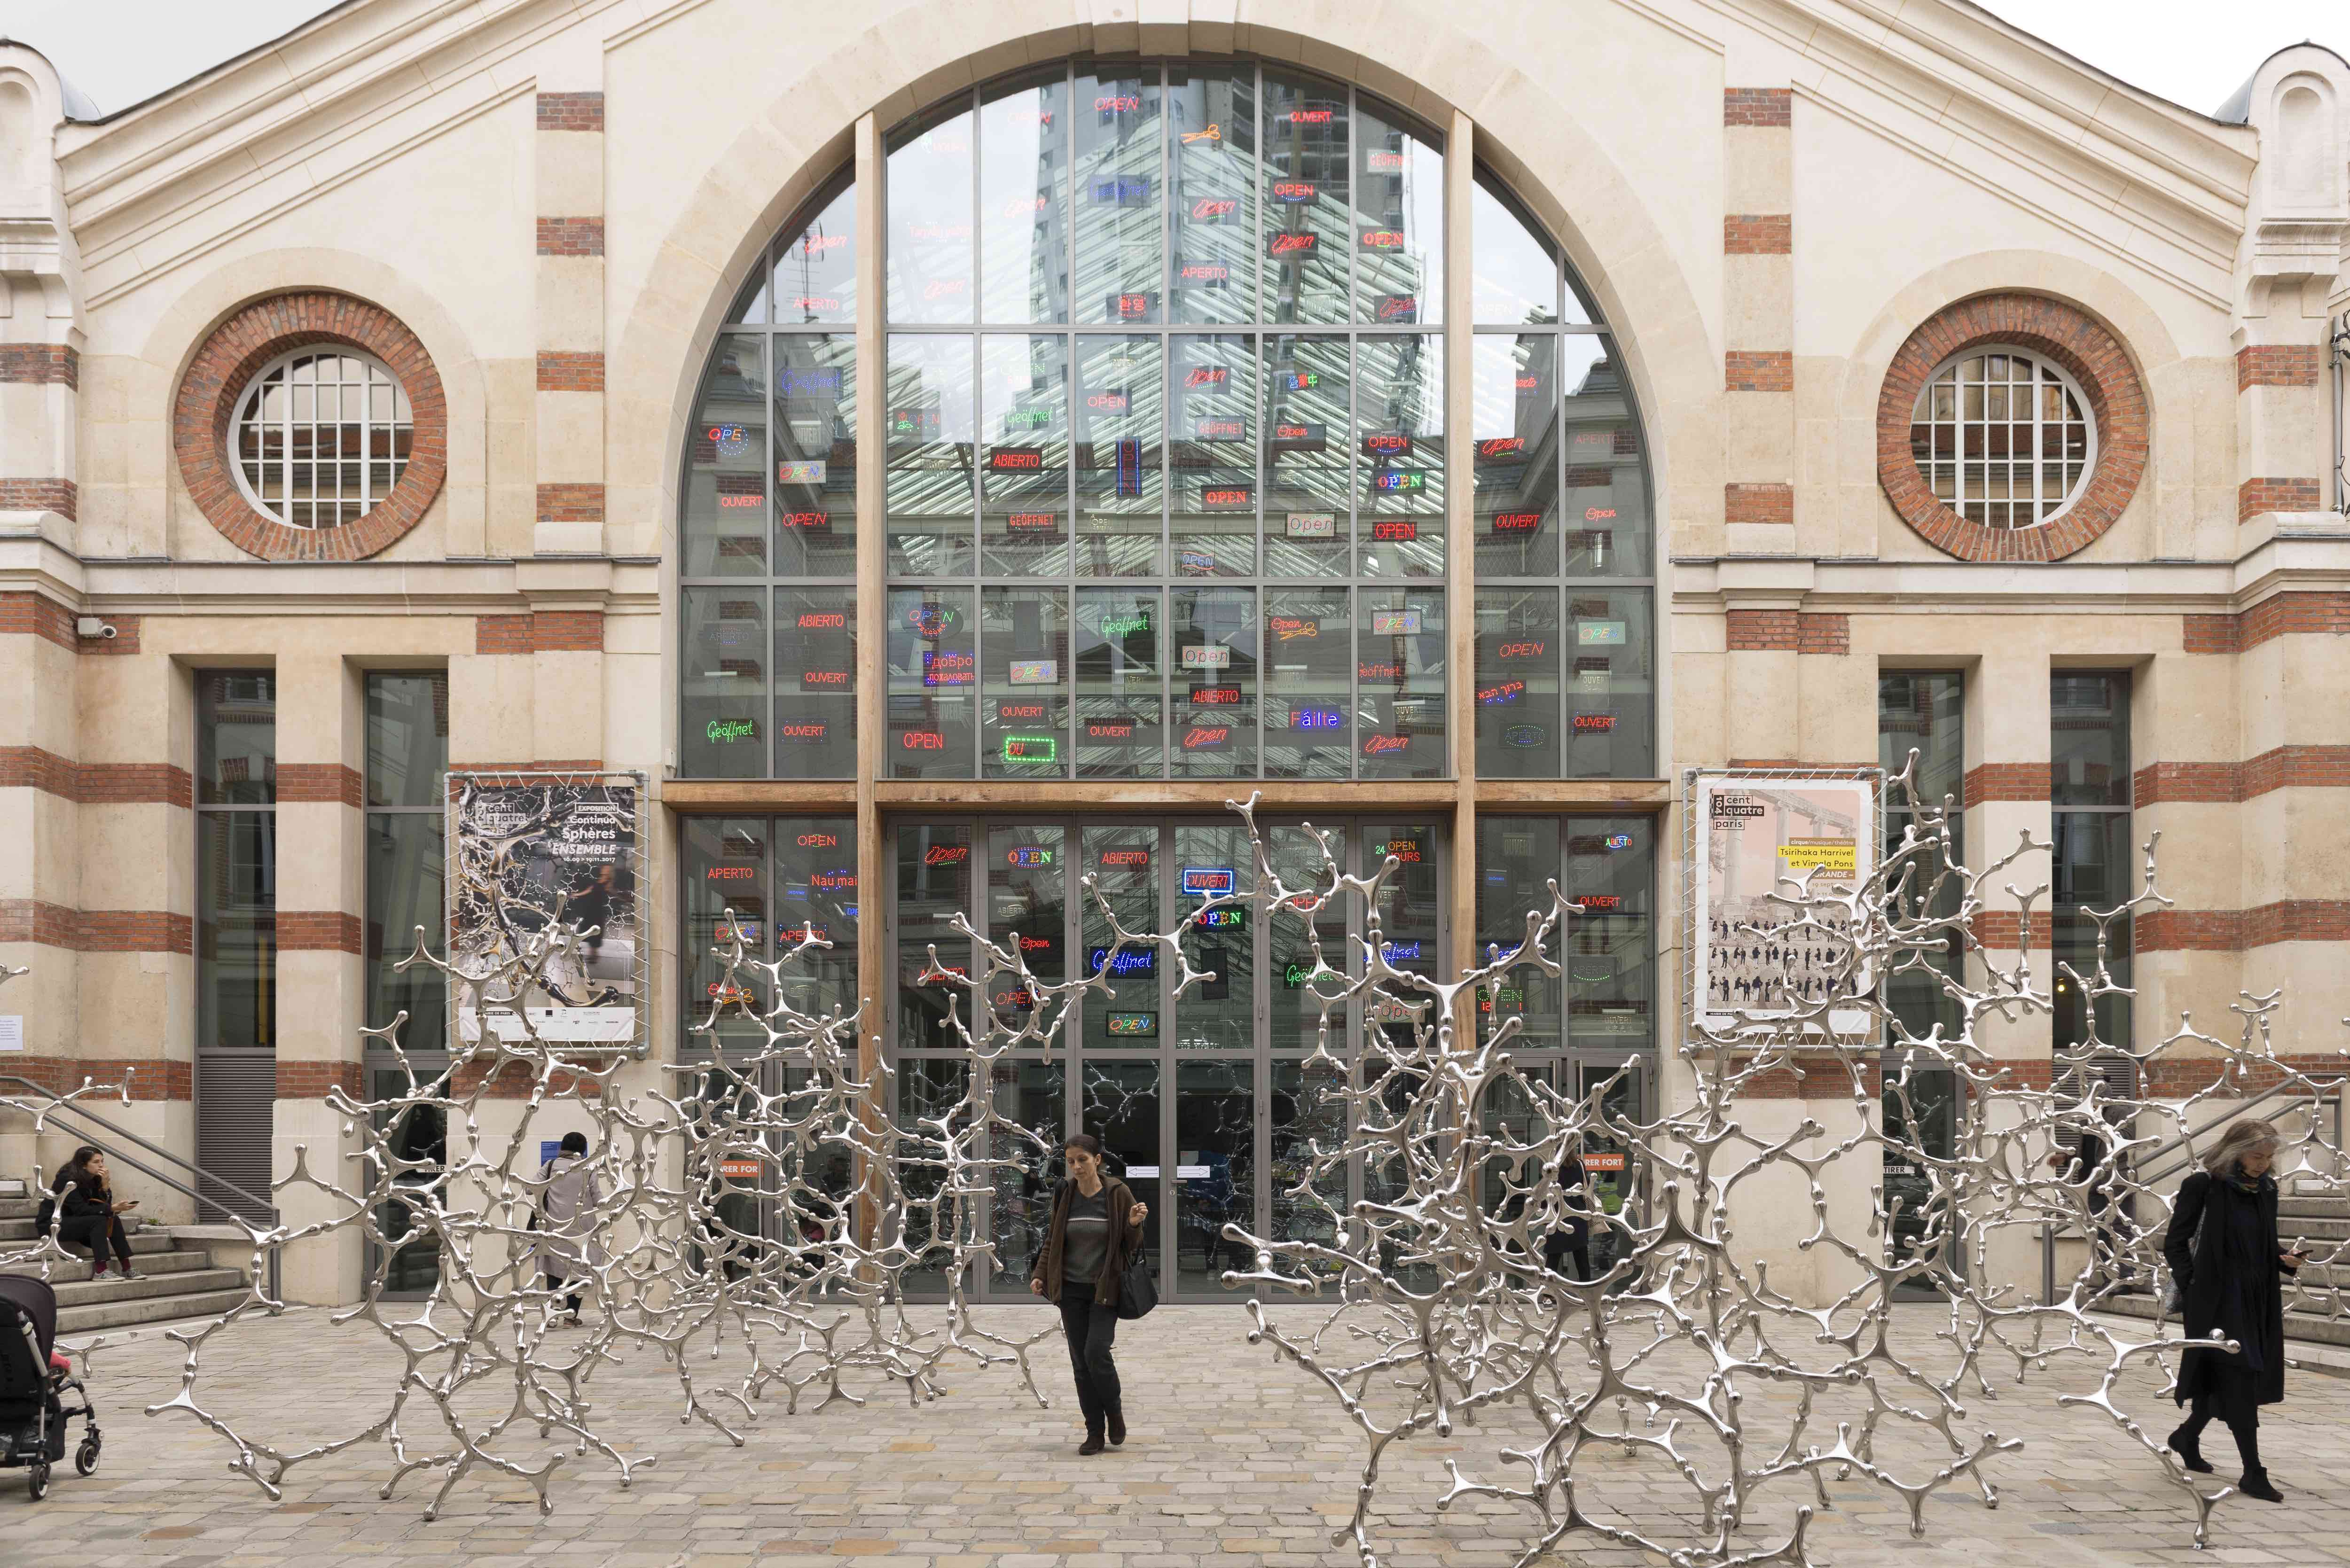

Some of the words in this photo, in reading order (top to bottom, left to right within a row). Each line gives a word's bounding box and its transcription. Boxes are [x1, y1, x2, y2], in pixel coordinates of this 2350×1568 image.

[1095, 97, 1138, 110] OPEN
[1291, 111, 1332, 122] OUVERT
[1275, 184, 1313, 196] OPEN
[1193, 200, 1235, 218] Open
[1271, 234, 1314, 255] Open
[1364, 233, 1403, 245] OPEN
[1182, 267, 1227, 278] APERTO
[793, 297, 838, 310] APERTO
[1185, 369, 1226, 387] Open
[1088, 397, 1126, 407] OPEN
[1008, 407, 1053, 427] Geöffnet
[1199, 421, 1242, 433] GEÖFFNET
[1278, 424, 1308, 437] Open
[1369, 437, 1407, 447] OPEN
[1575, 434, 1618, 444] APERTO
[1482, 438, 1524, 454] Open
[994, 455, 1039, 466] ABIERTO
[1123, 440, 1135, 493] OPEN
[780, 465, 819, 478] OPEN
[1378, 476, 1421, 488] OPEN
[721, 496, 763, 507] OUVERT
[1207, 491, 1246, 503] OPEN
[783, 512, 827, 527] OPEN
[1010, 513, 1053, 525] GEÖFFNET
[1496, 515, 1540, 527] OUVERT
[1587, 508, 1616, 522] Open
[1291, 518, 1332, 530] Open
[1376, 524, 1414, 538] OPEN
[1183, 555, 1214, 567] OPEN
[799, 615, 844, 627] ABIERTO
[909, 610, 954, 623] OPEN
[1102, 615, 1147, 639] Geöffnet
[1271, 617, 1300, 630] Open
[1375, 618, 1414, 629] OPEN
[1580, 628, 1616, 639] OPEN
[1186, 649, 1228, 663] Open
[1500, 643, 1543, 657] OPEN
[806, 672, 847, 683] OUVERT
[1011, 665, 1050, 679] OPEN
[1193, 691, 1238, 703] ABIERTO
[1003, 707, 1043, 717] OUVERT
[1292, 711, 1339, 726] Fáilte
[1575, 717, 1615, 727] OUVERT
[707, 720, 753, 742] Geöffnet
[784, 725, 825, 736] OUVERT
[1090, 725, 1131, 737] OUVERT
[904, 733, 943, 748] OPEN
[1185, 729, 1226, 748] Open
[1366, 735, 1408, 753] Open
[1726, 807, 1763, 816] quatre
[1716, 819, 1743, 830] paris
[563, 827, 615, 842] Sphères
[798, 835, 836, 846] OPEN
[1388, 842, 1415, 850] OPEN
[1606, 838, 1632, 846] ABIERTO
[552, 844, 616, 855] ENSEMBLE
[925, 846, 967, 865] Open
[1376, 846, 1385, 854] 24
[1009, 851, 1052, 864] OPEN
[1102, 852, 1147, 864] ABIERTO
[708, 868, 752, 879] APERTO
[812, 874, 834, 886] Nau
[1187, 875, 1228, 887] OUVERT
[1580, 897, 1620, 906] OUVERT
[1197, 912, 1240, 925] OPEN
[1020, 937, 1049, 950] Open
[1478, 990, 1522, 1001] OEN
[1110, 1019, 1149, 1030] OPEN
